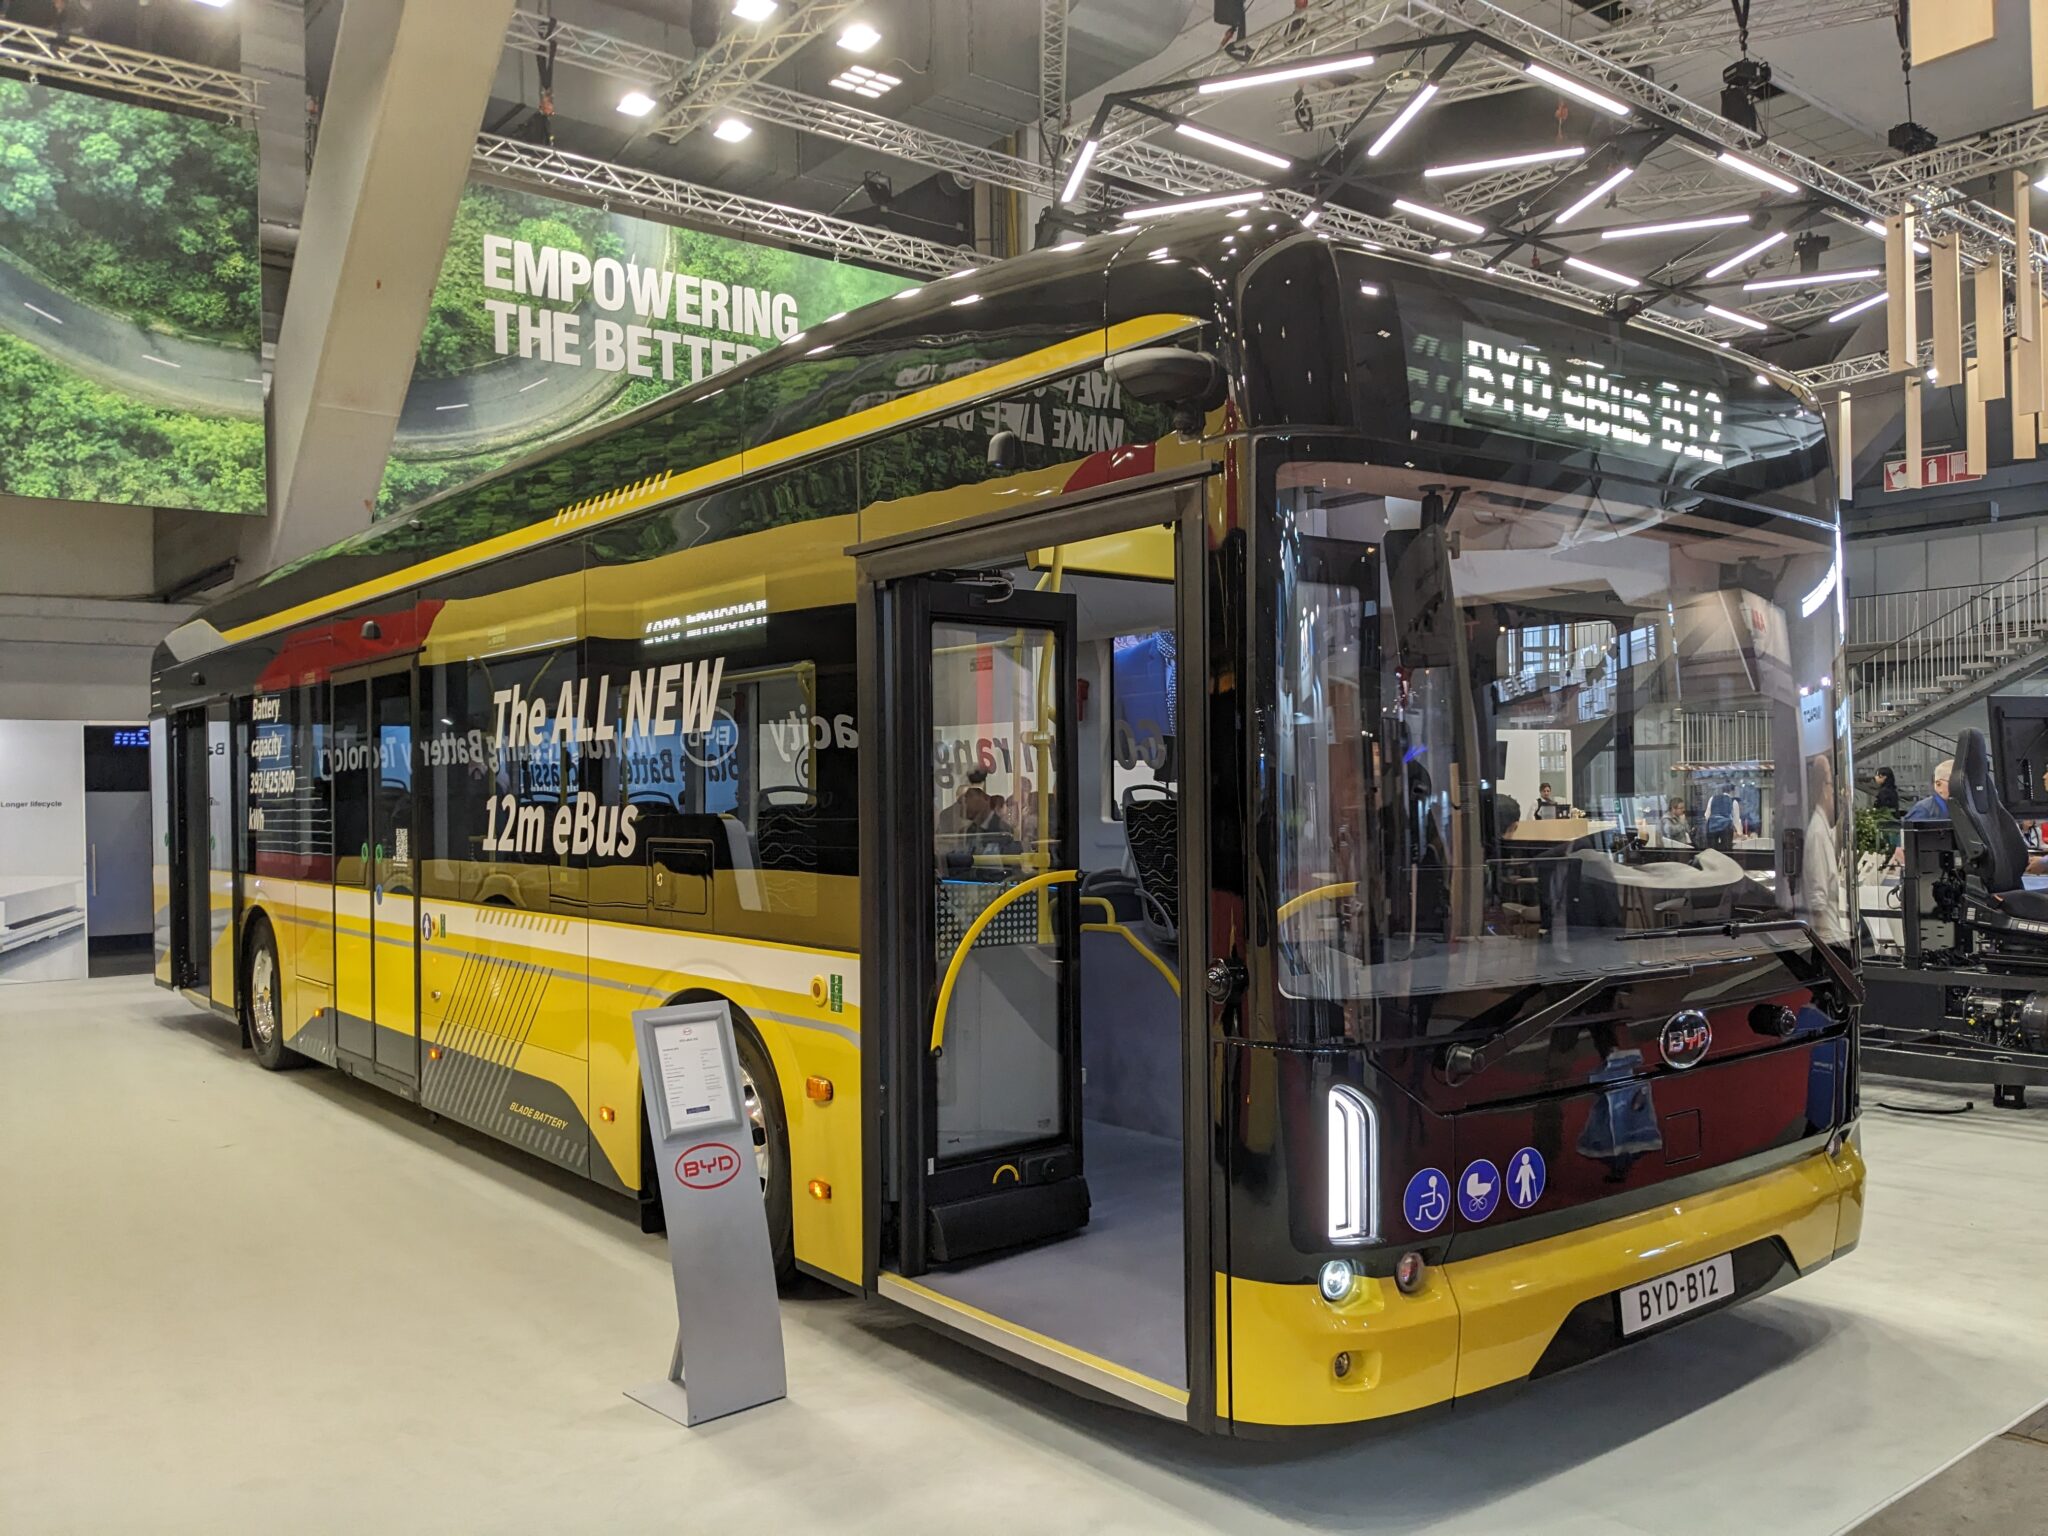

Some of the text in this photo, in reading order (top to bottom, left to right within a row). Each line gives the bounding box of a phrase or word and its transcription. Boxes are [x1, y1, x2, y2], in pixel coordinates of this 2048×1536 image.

[483, 234, 798, 341] EMPOWERING
[484, 299, 581, 366] THE
[252, 697, 281, 723] Battery
[493, 656, 726, 749] The ALL NEW
[251, 731, 283, 762] capacity
[250, 769, 295, 798] 392/425/500
[0, 800, 62, 809] Longer lifecycle
[248, 807, 265, 832] kWh
[482, 791, 639, 858] 12m eBus
[509, 1101, 569, 1131] BLADE BATTERY
[683, 1154, 734, 1178] BYD
[1638, 1264, 1719, 1322] BYD-B12
